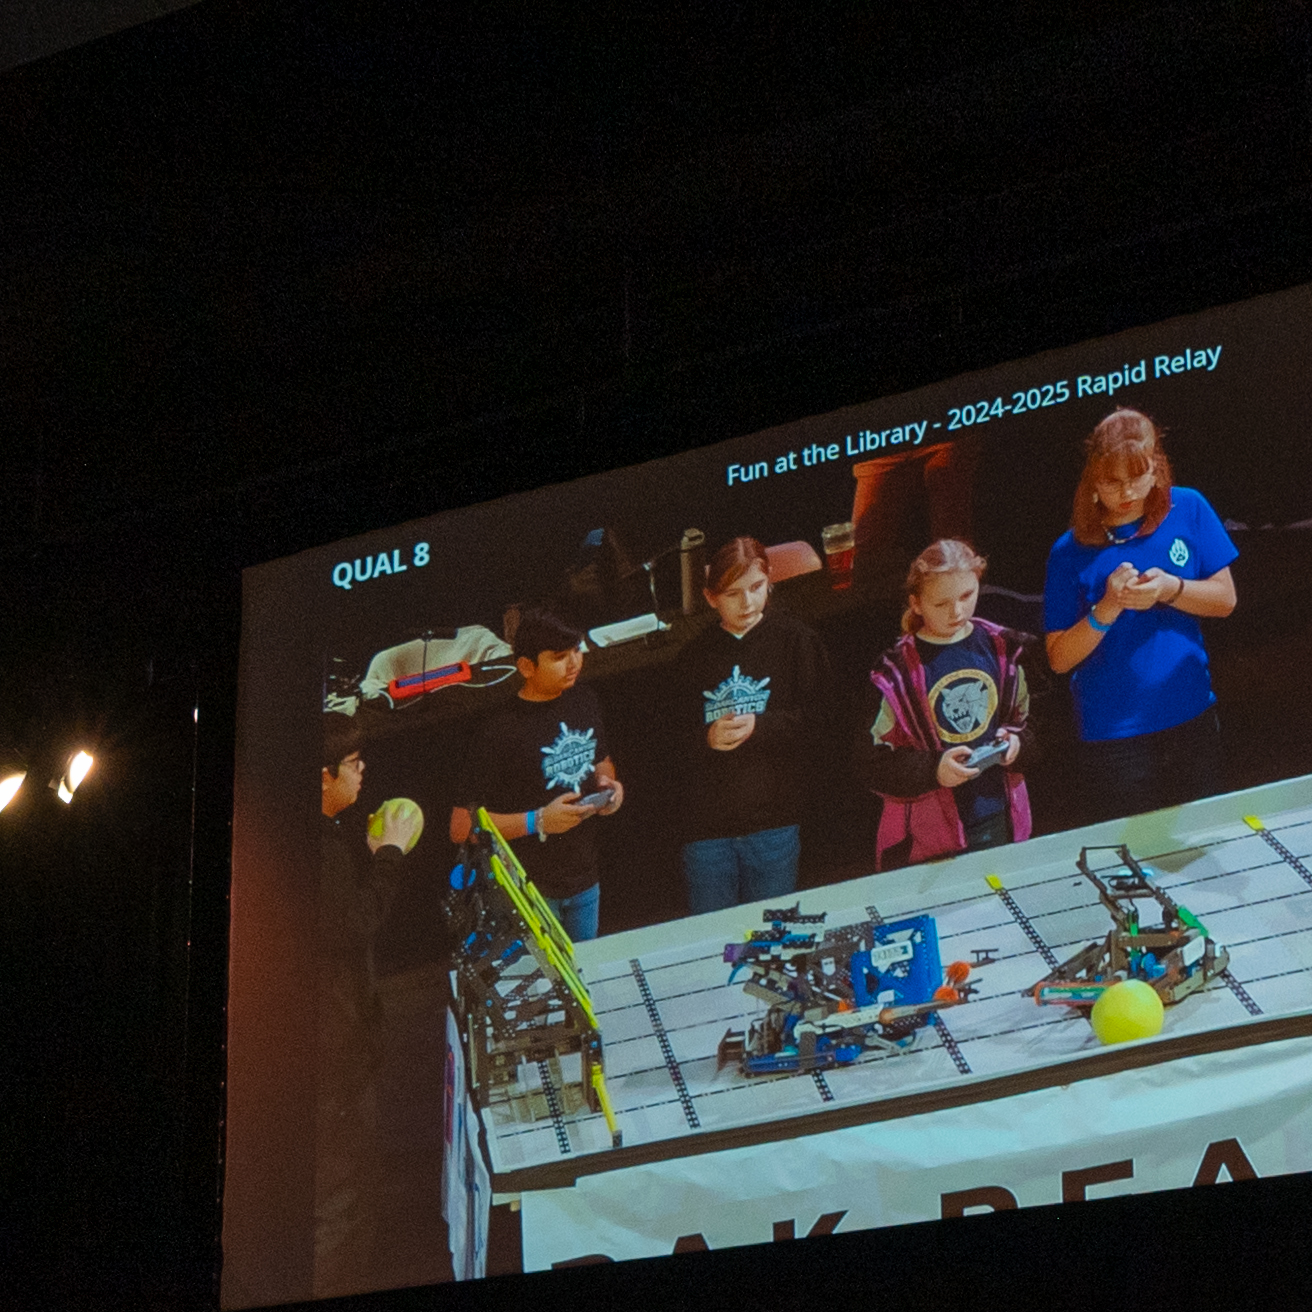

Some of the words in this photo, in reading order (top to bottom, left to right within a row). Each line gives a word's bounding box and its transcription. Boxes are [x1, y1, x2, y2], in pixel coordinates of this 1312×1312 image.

[726, 461, 769, 486] Fun
[775, 451, 798, 473] at
[803, 440, 840, 467] the
[845, 418, 929, 457] Library
[947, 381, 1070, 432] 2024-2025
[1076, 360, 1147, 398] Rapid
[1153, 345, 1224, 376] Relay
[332, 549, 407, 589] QUAL
[413, 541, 431, 568] 8
